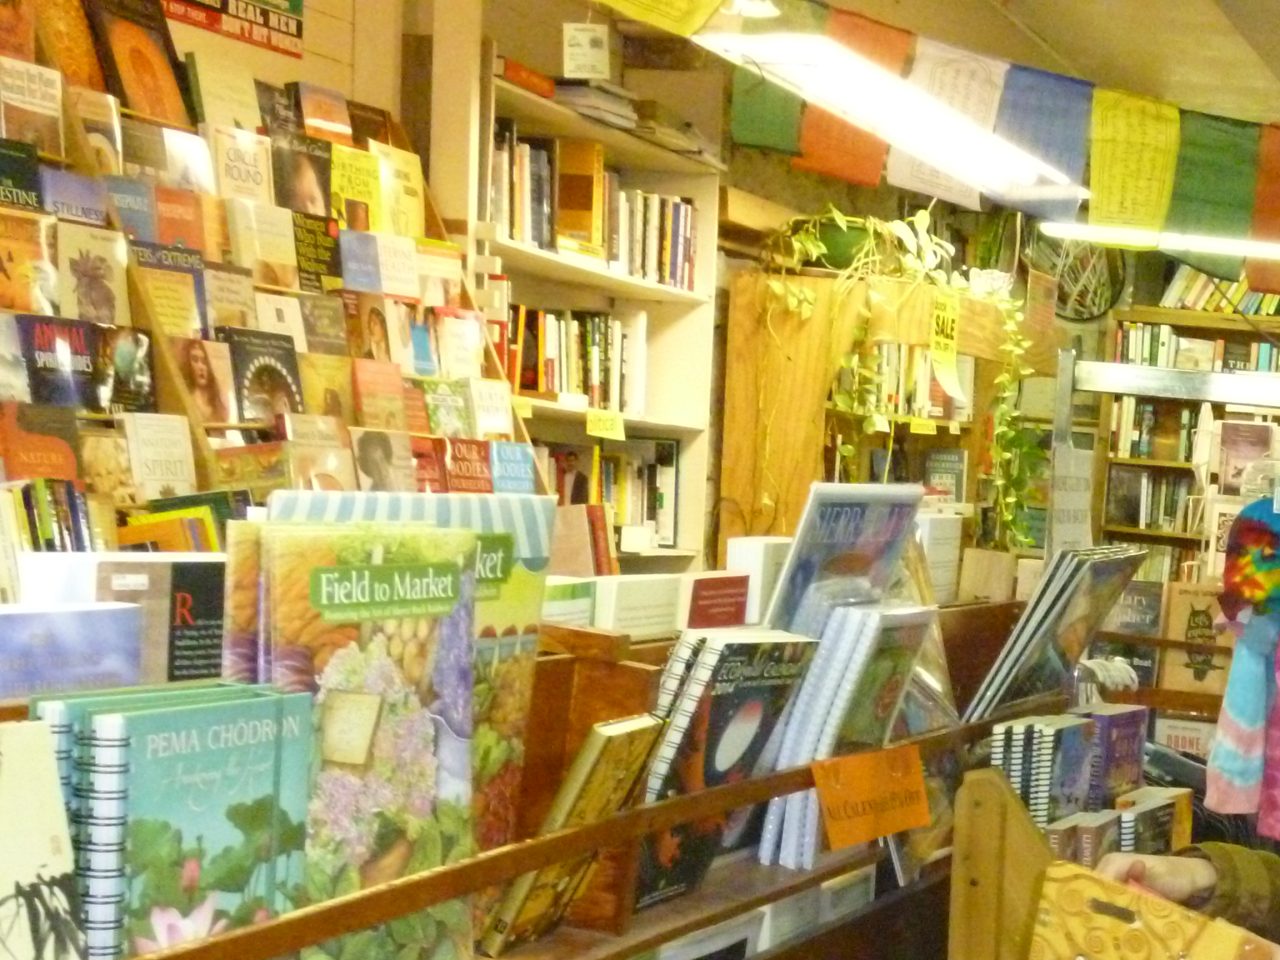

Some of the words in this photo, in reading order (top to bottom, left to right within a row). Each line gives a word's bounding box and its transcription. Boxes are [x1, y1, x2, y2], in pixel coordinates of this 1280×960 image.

[268, 9, 297, 36] MEN
[226, 145, 259, 168] CIRCLE
[225, 163, 263, 186] ROUND
[934, 314, 956, 341] SALE
[455, 443, 478, 459] OUR
[142, 459, 186, 477] SPIRIT
[320, 570, 370, 604] Field
[374, 581, 390, 601] to
[394, 568, 454, 601] Market
[147, 729, 200, 759] PEMA
